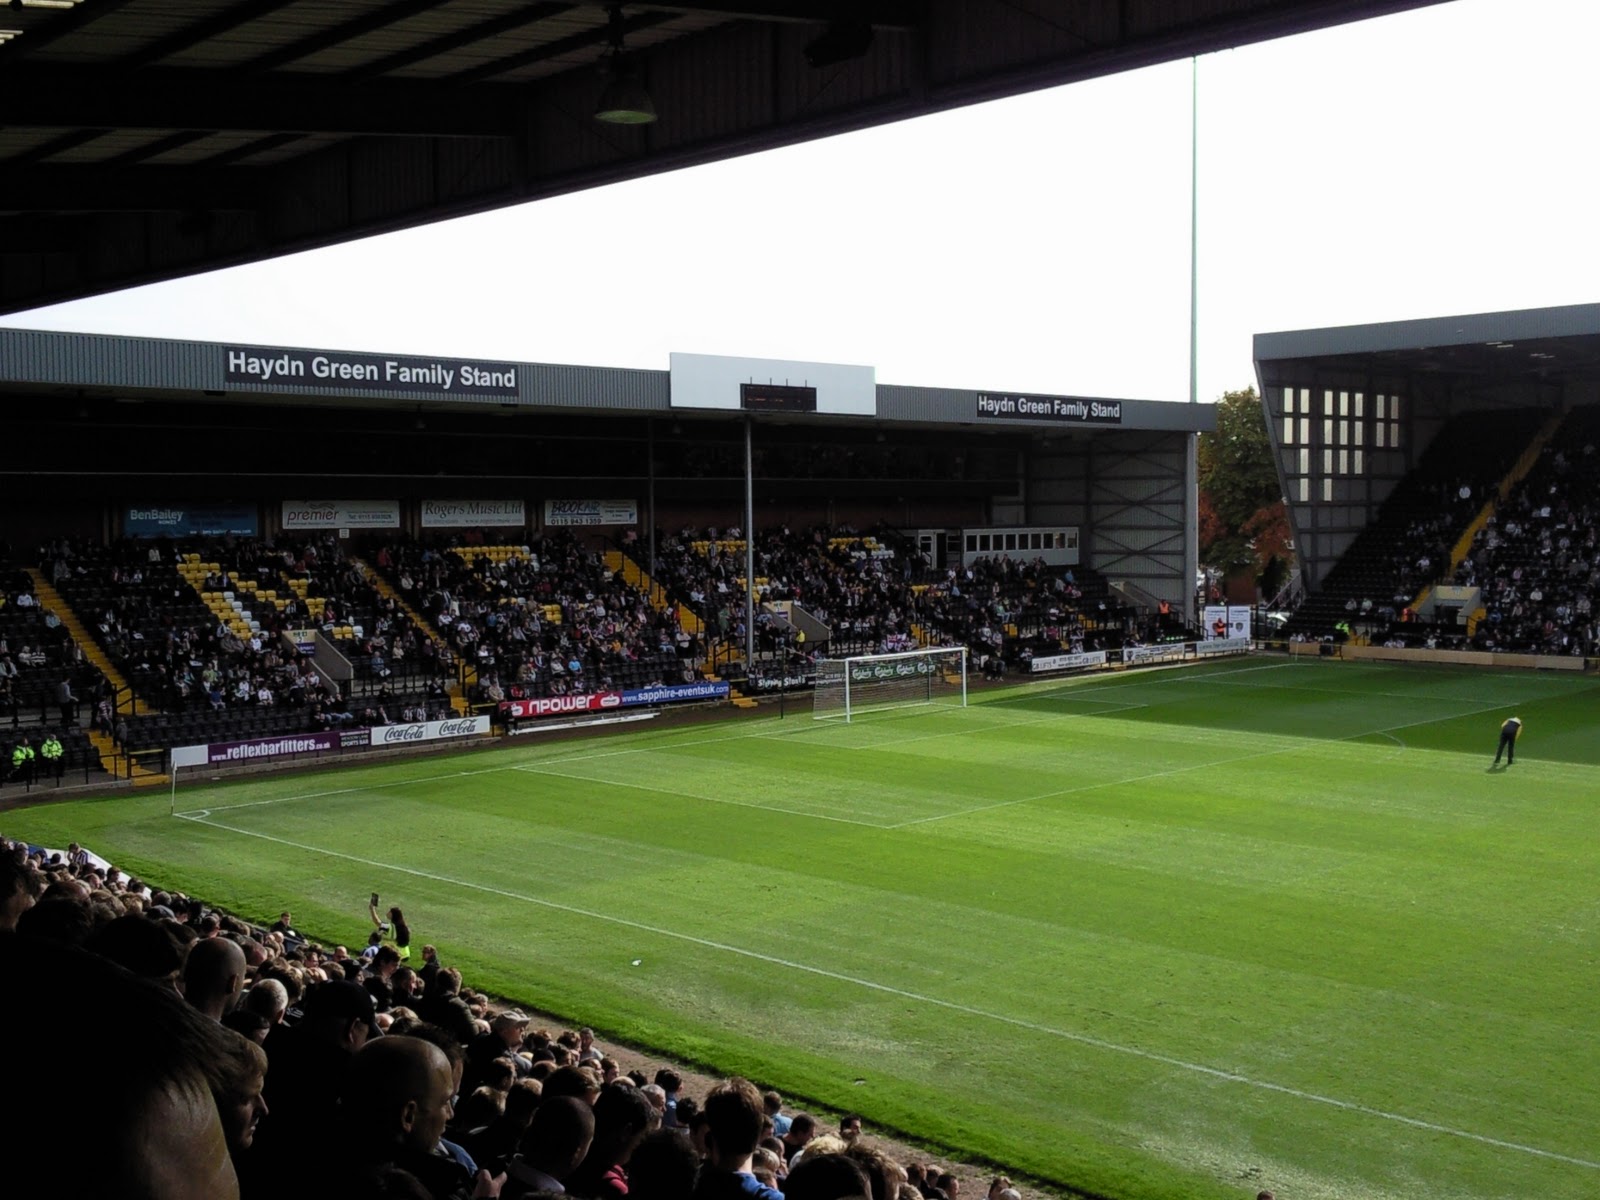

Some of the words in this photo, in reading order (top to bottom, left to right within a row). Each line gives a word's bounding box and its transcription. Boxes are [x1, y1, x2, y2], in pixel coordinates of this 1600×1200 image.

[228, 351, 304, 379] Haydn
[312, 356, 378, 381] Green
[385, 361, 454, 389] Family
[460, 366, 516, 388] Stand
[978, 395, 1015, 415] Haydn
[1017, 398, 1052, 415] Green
[1053, 400, 1089, 419] Family
[1091, 402, 1120, 418] Stand
[130, 509, 183, 521] BenBailey
[287, 509, 339, 525] premier
[467, 501, 500, 515] Music
[503, 501, 522, 514] Ltd
[621, 684, 729, 703] www.sapphire-eventsuk.com
[528, 695, 595, 713] npower
[211, 739, 331, 761] www.reflexbarfitters.co.uk
